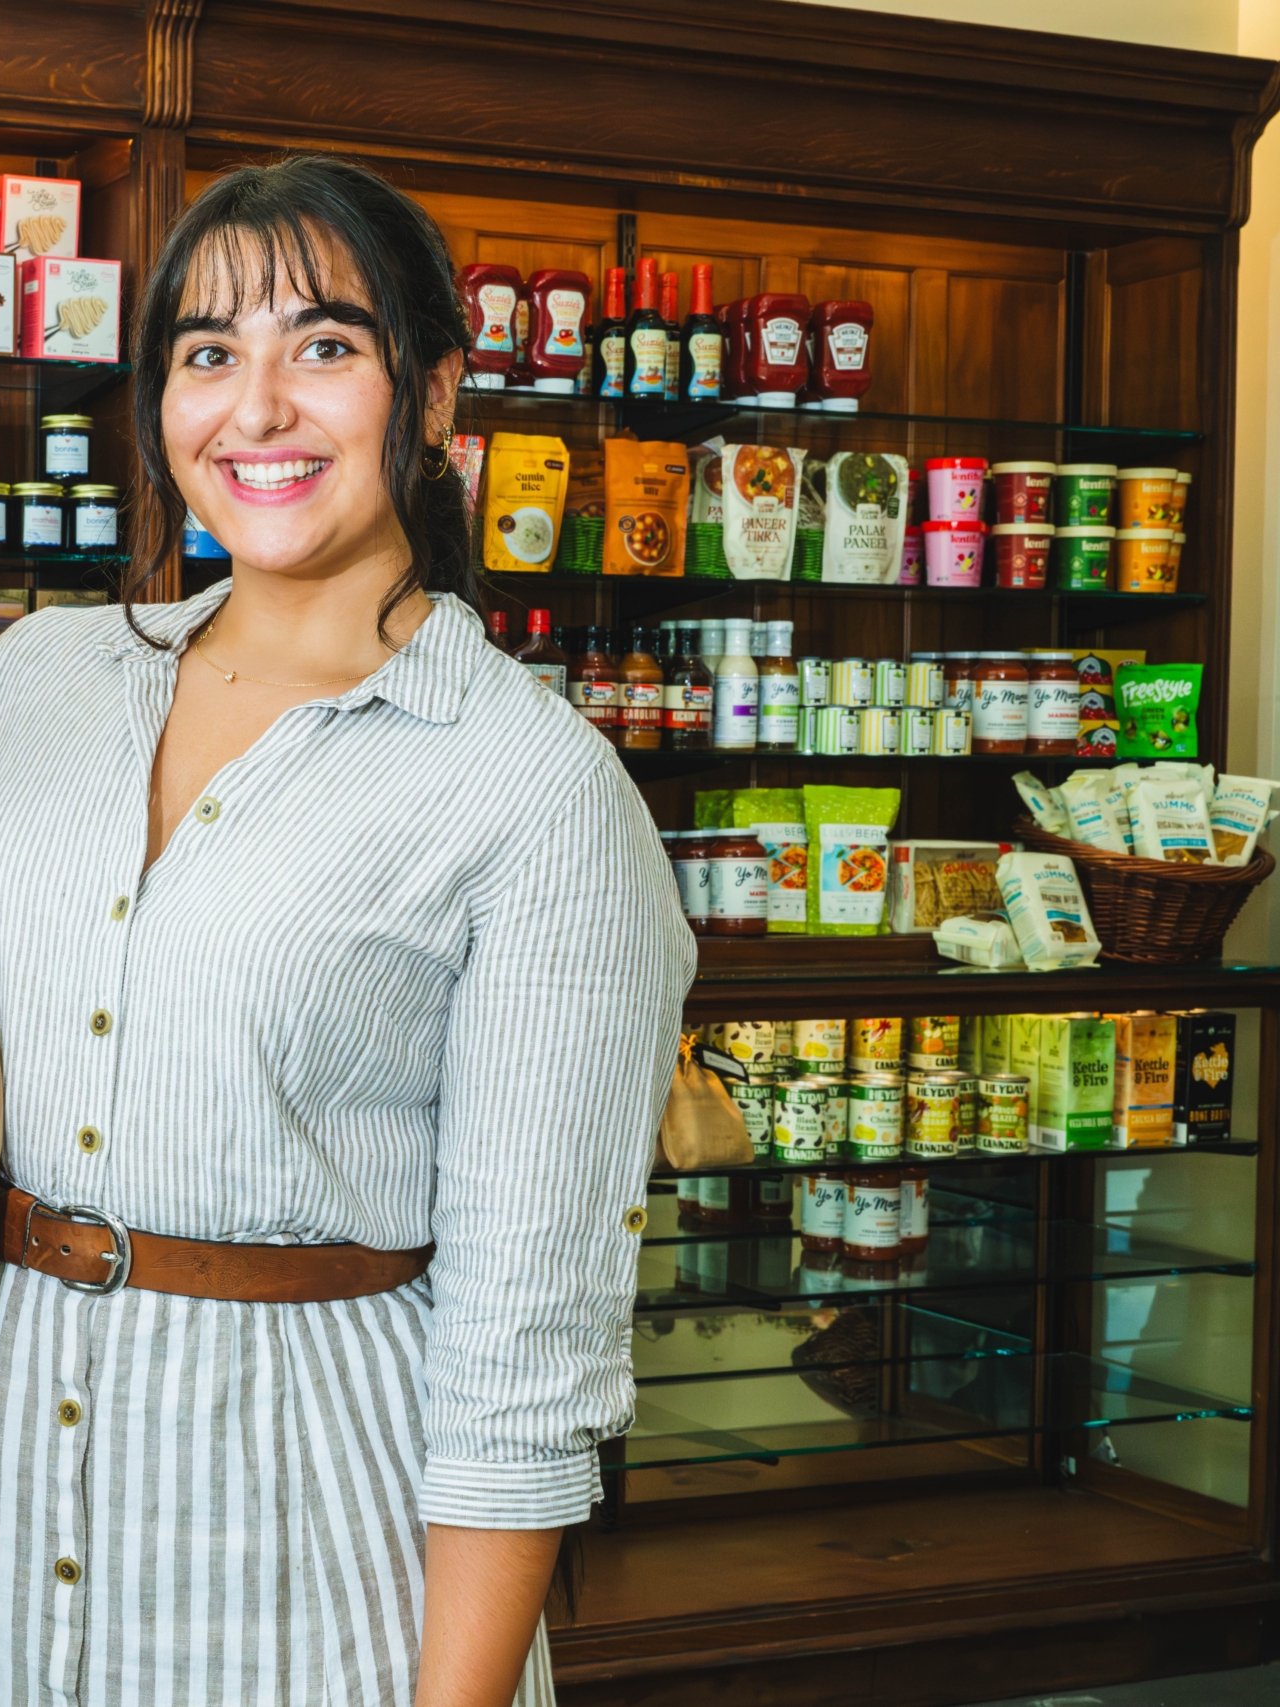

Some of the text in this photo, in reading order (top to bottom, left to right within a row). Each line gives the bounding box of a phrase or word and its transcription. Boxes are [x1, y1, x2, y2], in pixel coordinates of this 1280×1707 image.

[775, 322, 793, 331] HEINZ
[841, 328, 859, 337] HEINZ
[636, 333, 666, 349] Suzie
[54, 445, 80, 453] bonnie
[515, 472, 545, 483] Cumin
[1025, 476, 1051, 489] lenti
[521, 482, 541, 492] Rice
[742, 517, 786, 530] PANEER
[745, 530, 782, 543] TIKKA
[1024, 537, 1050, 549] lenti
[1081, 540, 1111, 552] lenti
[981, 689, 998, 710] Yo
[1034, 687, 1051, 709] Yo
[1153, 800, 1197, 813] RUMMO
[855, 827, 886, 838] BEAN
[943, 861, 989, 876] RUMMO
[735, 866, 752, 887] Yo
[1033, 869, 1075, 884] RUMMO
[1072, 1059, 1109, 1075] Kettle
[1134, 1057, 1170, 1072] Kettle
[1192, 1054, 1229, 1070] Kettle
[1083, 1072, 1109, 1087] Fire
[1144, 1069, 1169, 1083] Fire
[1202, 1067, 1228, 1081] Fire
[916, 1086, 957, 1098] HEYDAY
[984, 1083, 1026, 1095] HEYDAY
[786, 1090, 826, 1104] HEYDAY
[796, 1115, 818, 1125] Black
[870, 1115, 901, 1125] Chickpe
[796, 1124, 819, 1133] Beans
[867, 1144, 902, 1157] CANNIN
[913, 1142, 955, 1153] CANNING
[982, 1138, 1024, 1151] CANNING
[783, 1149, 824, 1161] CANNING
[814, 1187, 833, 1208] Yo
[855, 1195, 871, 1216] Yo
